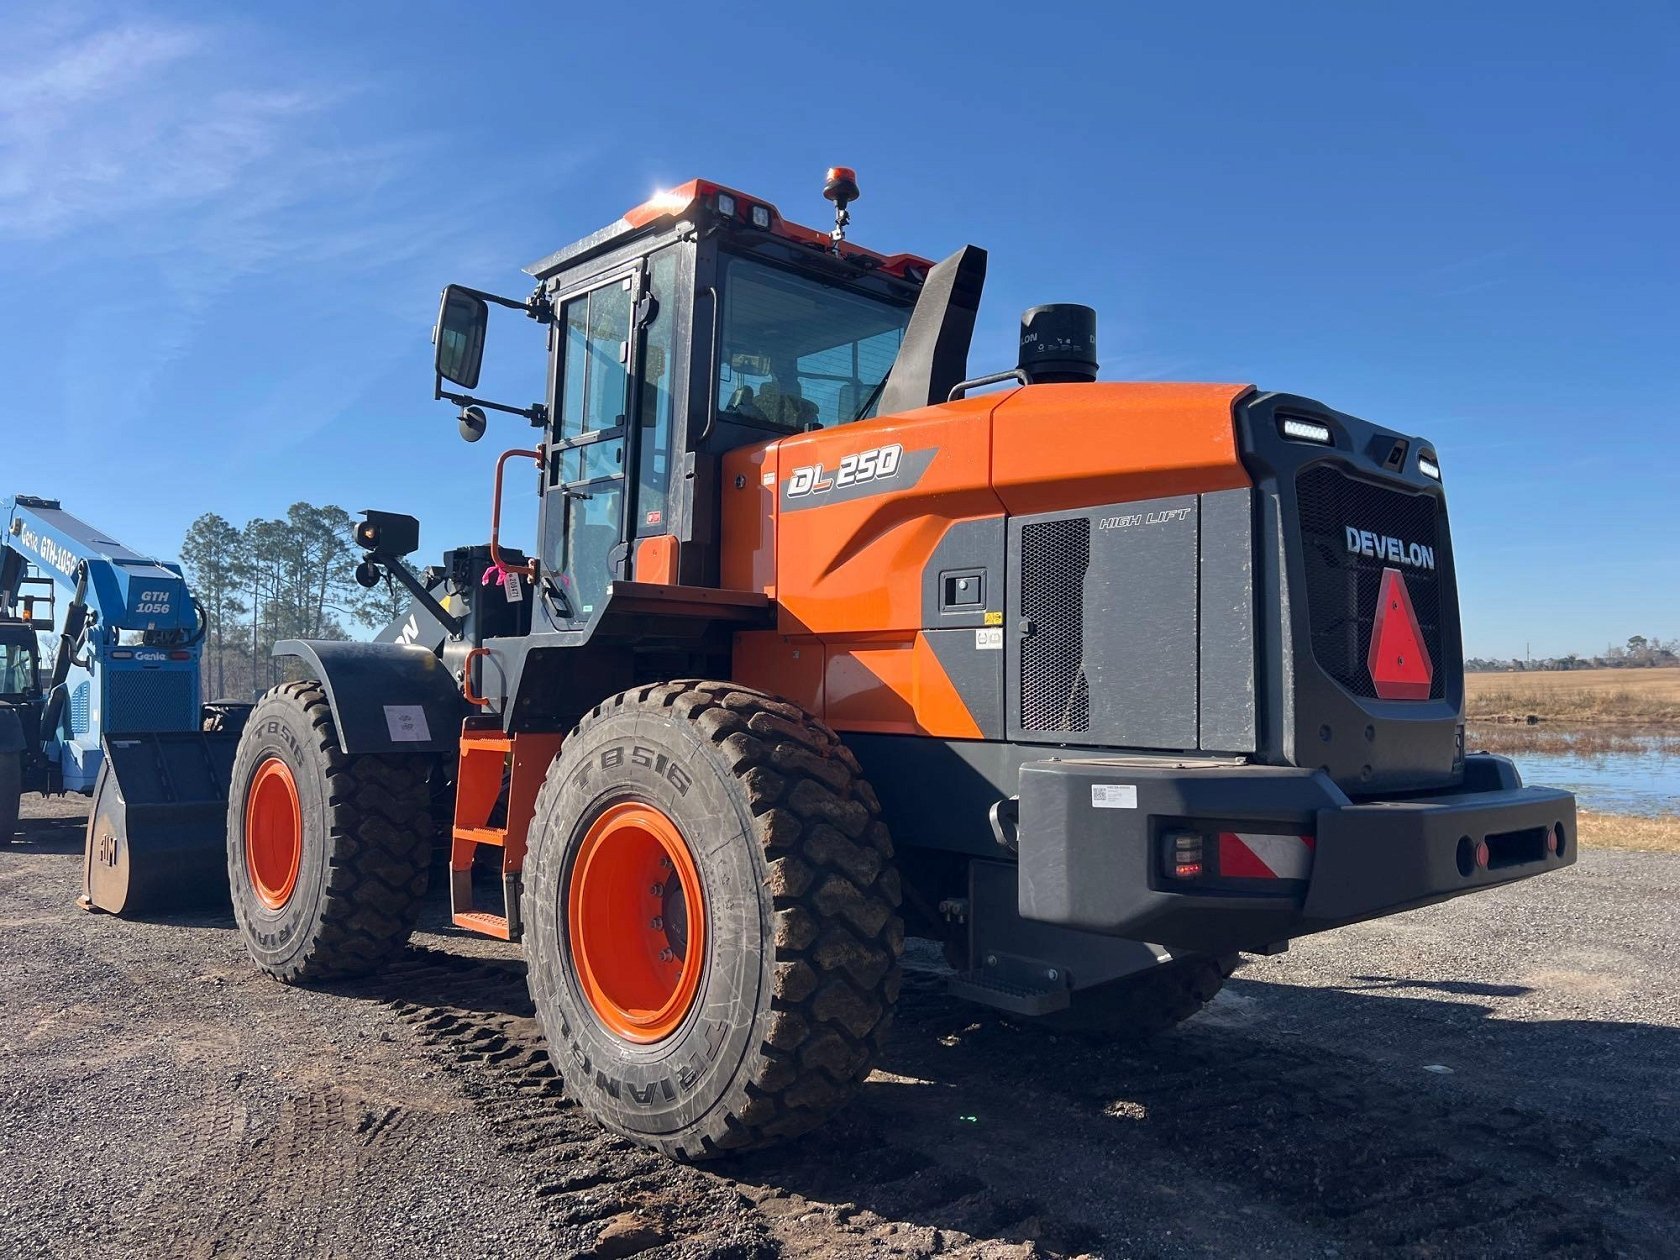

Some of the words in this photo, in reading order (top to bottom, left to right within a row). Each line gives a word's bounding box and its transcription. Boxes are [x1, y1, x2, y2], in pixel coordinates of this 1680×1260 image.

[787, 461, 834, 499] DL
[836, 443, 904, 490] 250
[1099, 514, 1142, 530] HIGH
[1145, 507, 1192, 525] LIFT
[21, 522, 39, 553] Genie
[1345, 525, 1435, 570] DEVELON
[135, 603, 171, 615] 1056
[141, 590, 170, 602] GTH
[135, 650, 168, 661] Genie
[571, 745, 693, 798] TB516
